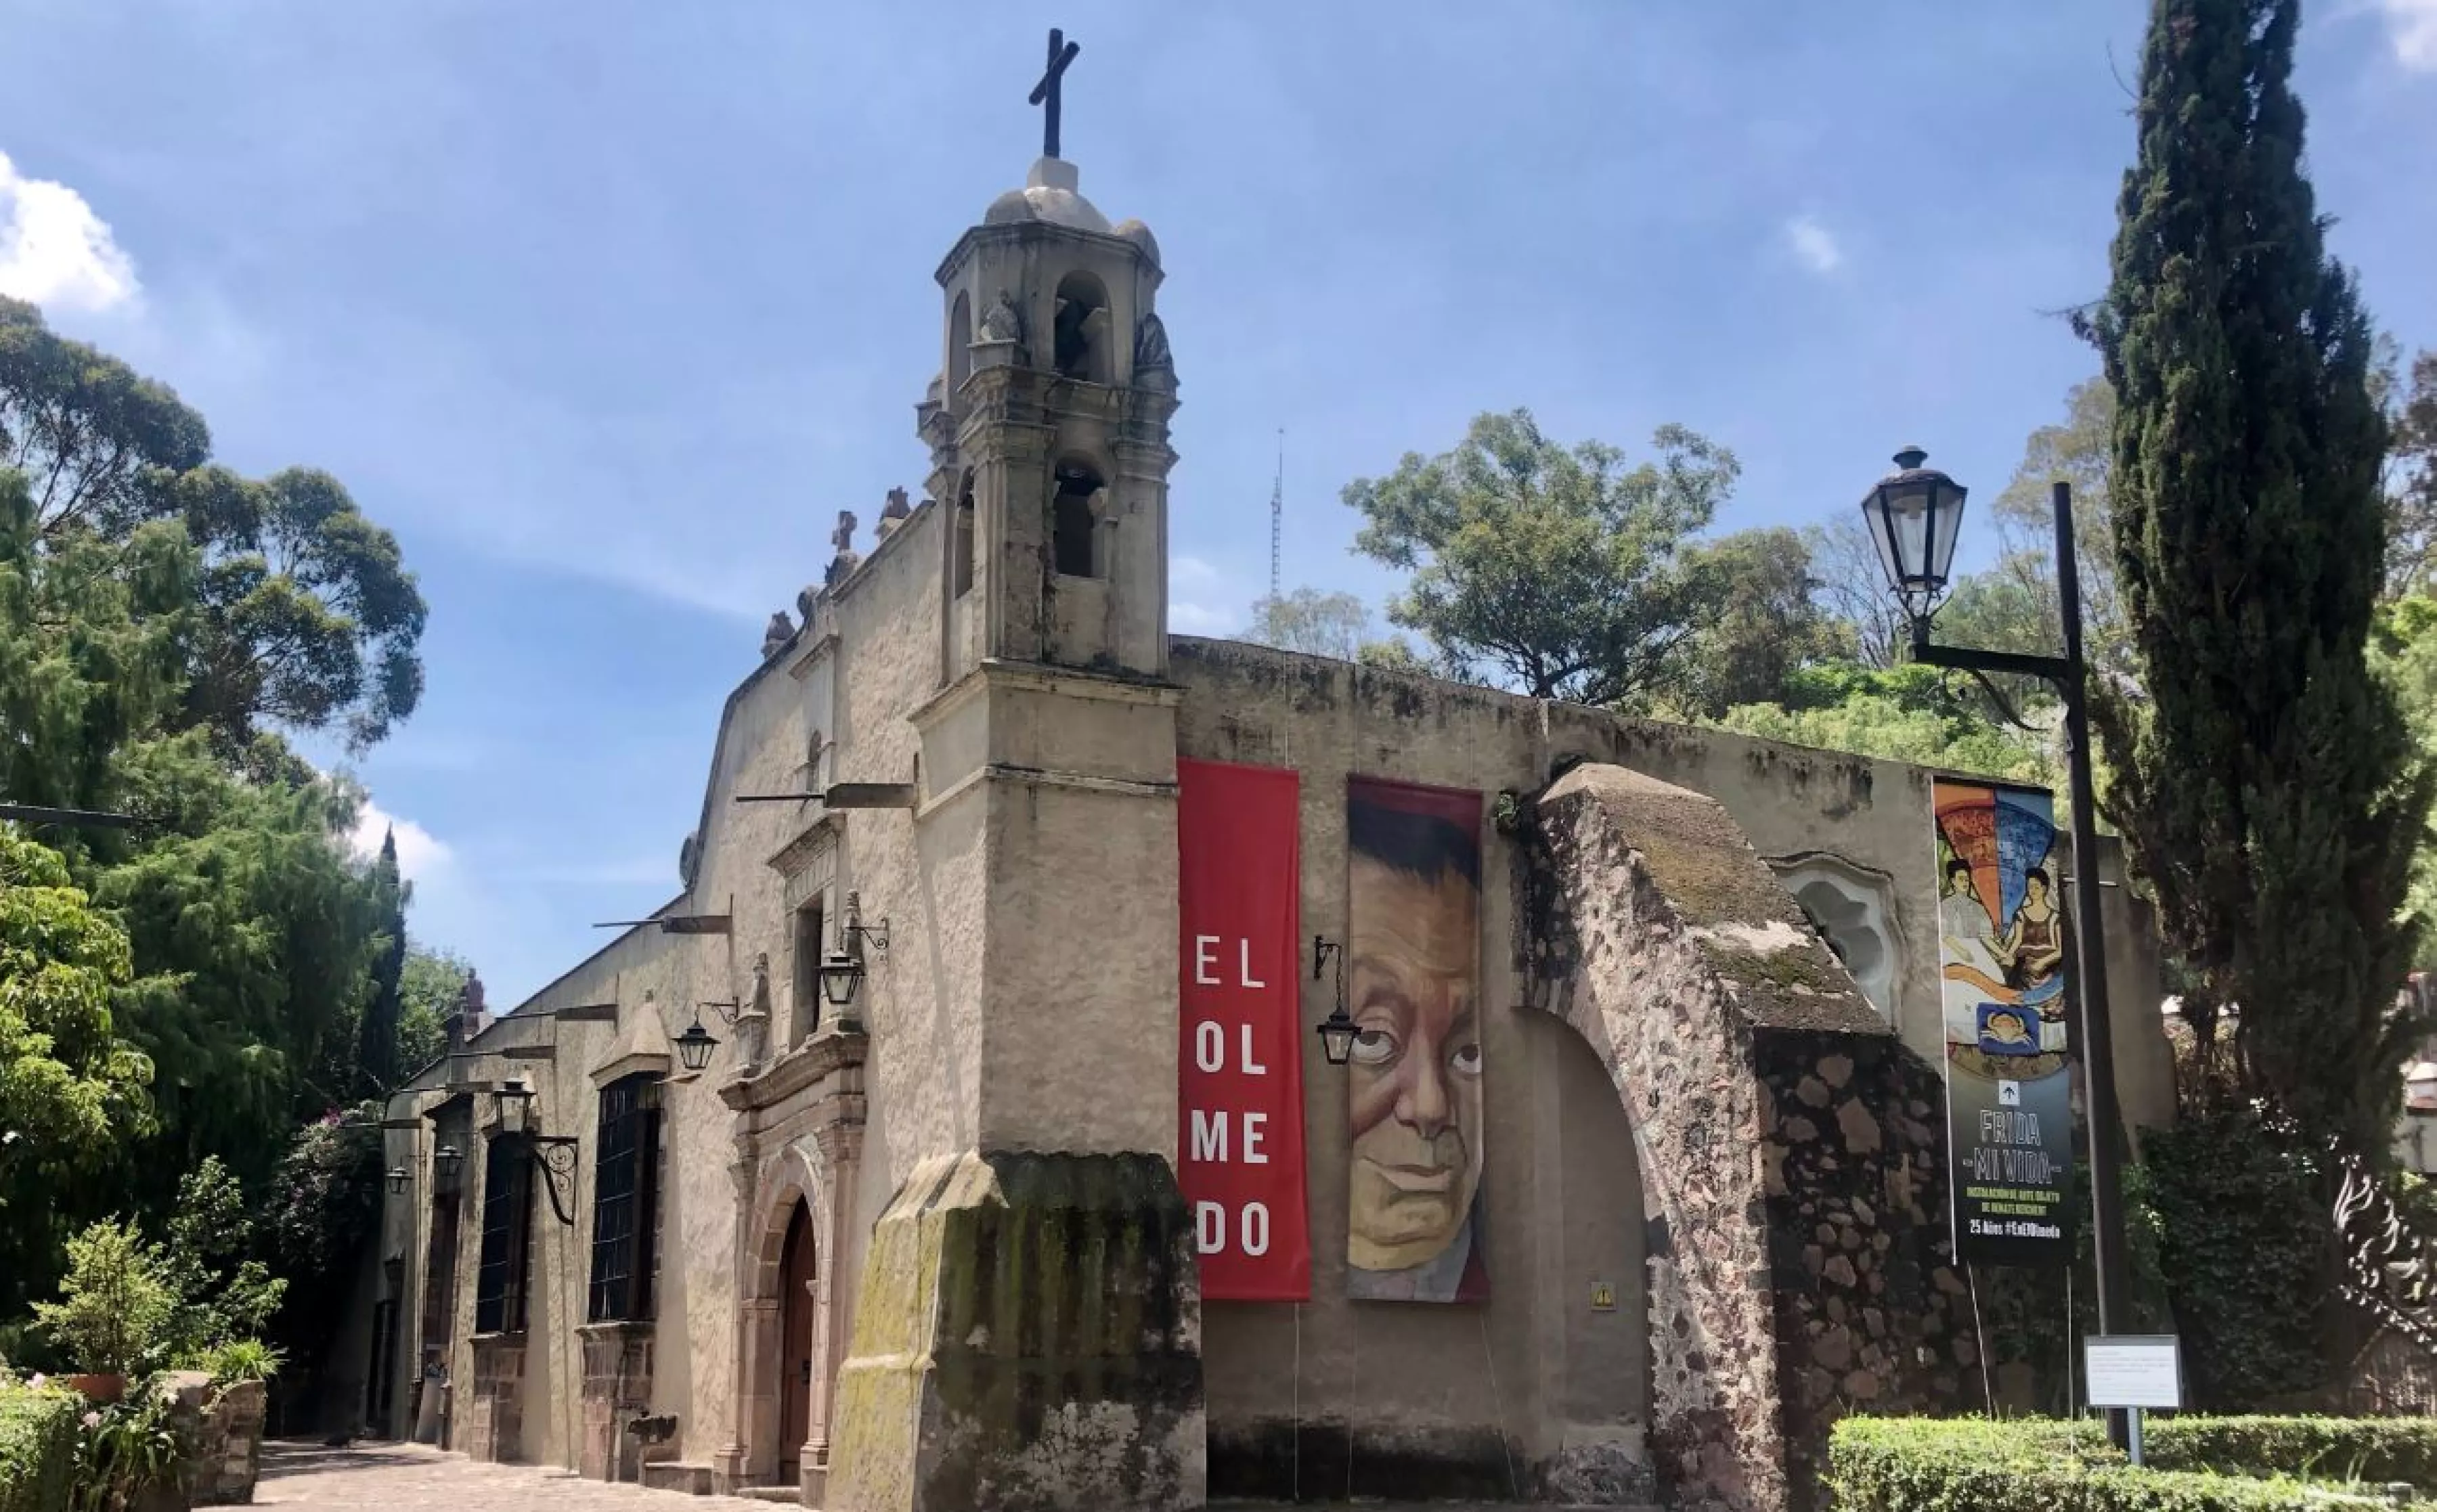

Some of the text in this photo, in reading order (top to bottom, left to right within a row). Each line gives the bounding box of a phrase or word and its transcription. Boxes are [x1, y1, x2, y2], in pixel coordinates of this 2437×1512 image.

[1195, 935, 1265, 988] EL
[1195, 1021, 1267, 1075] OL
[1190, 1109, 1269, 1163] ME
[1979, 1109, 2041, 1147] FRIDA
[1196, 1200, 1270, 1256] DO
[1970, 1219, 1981, 1234] 25
